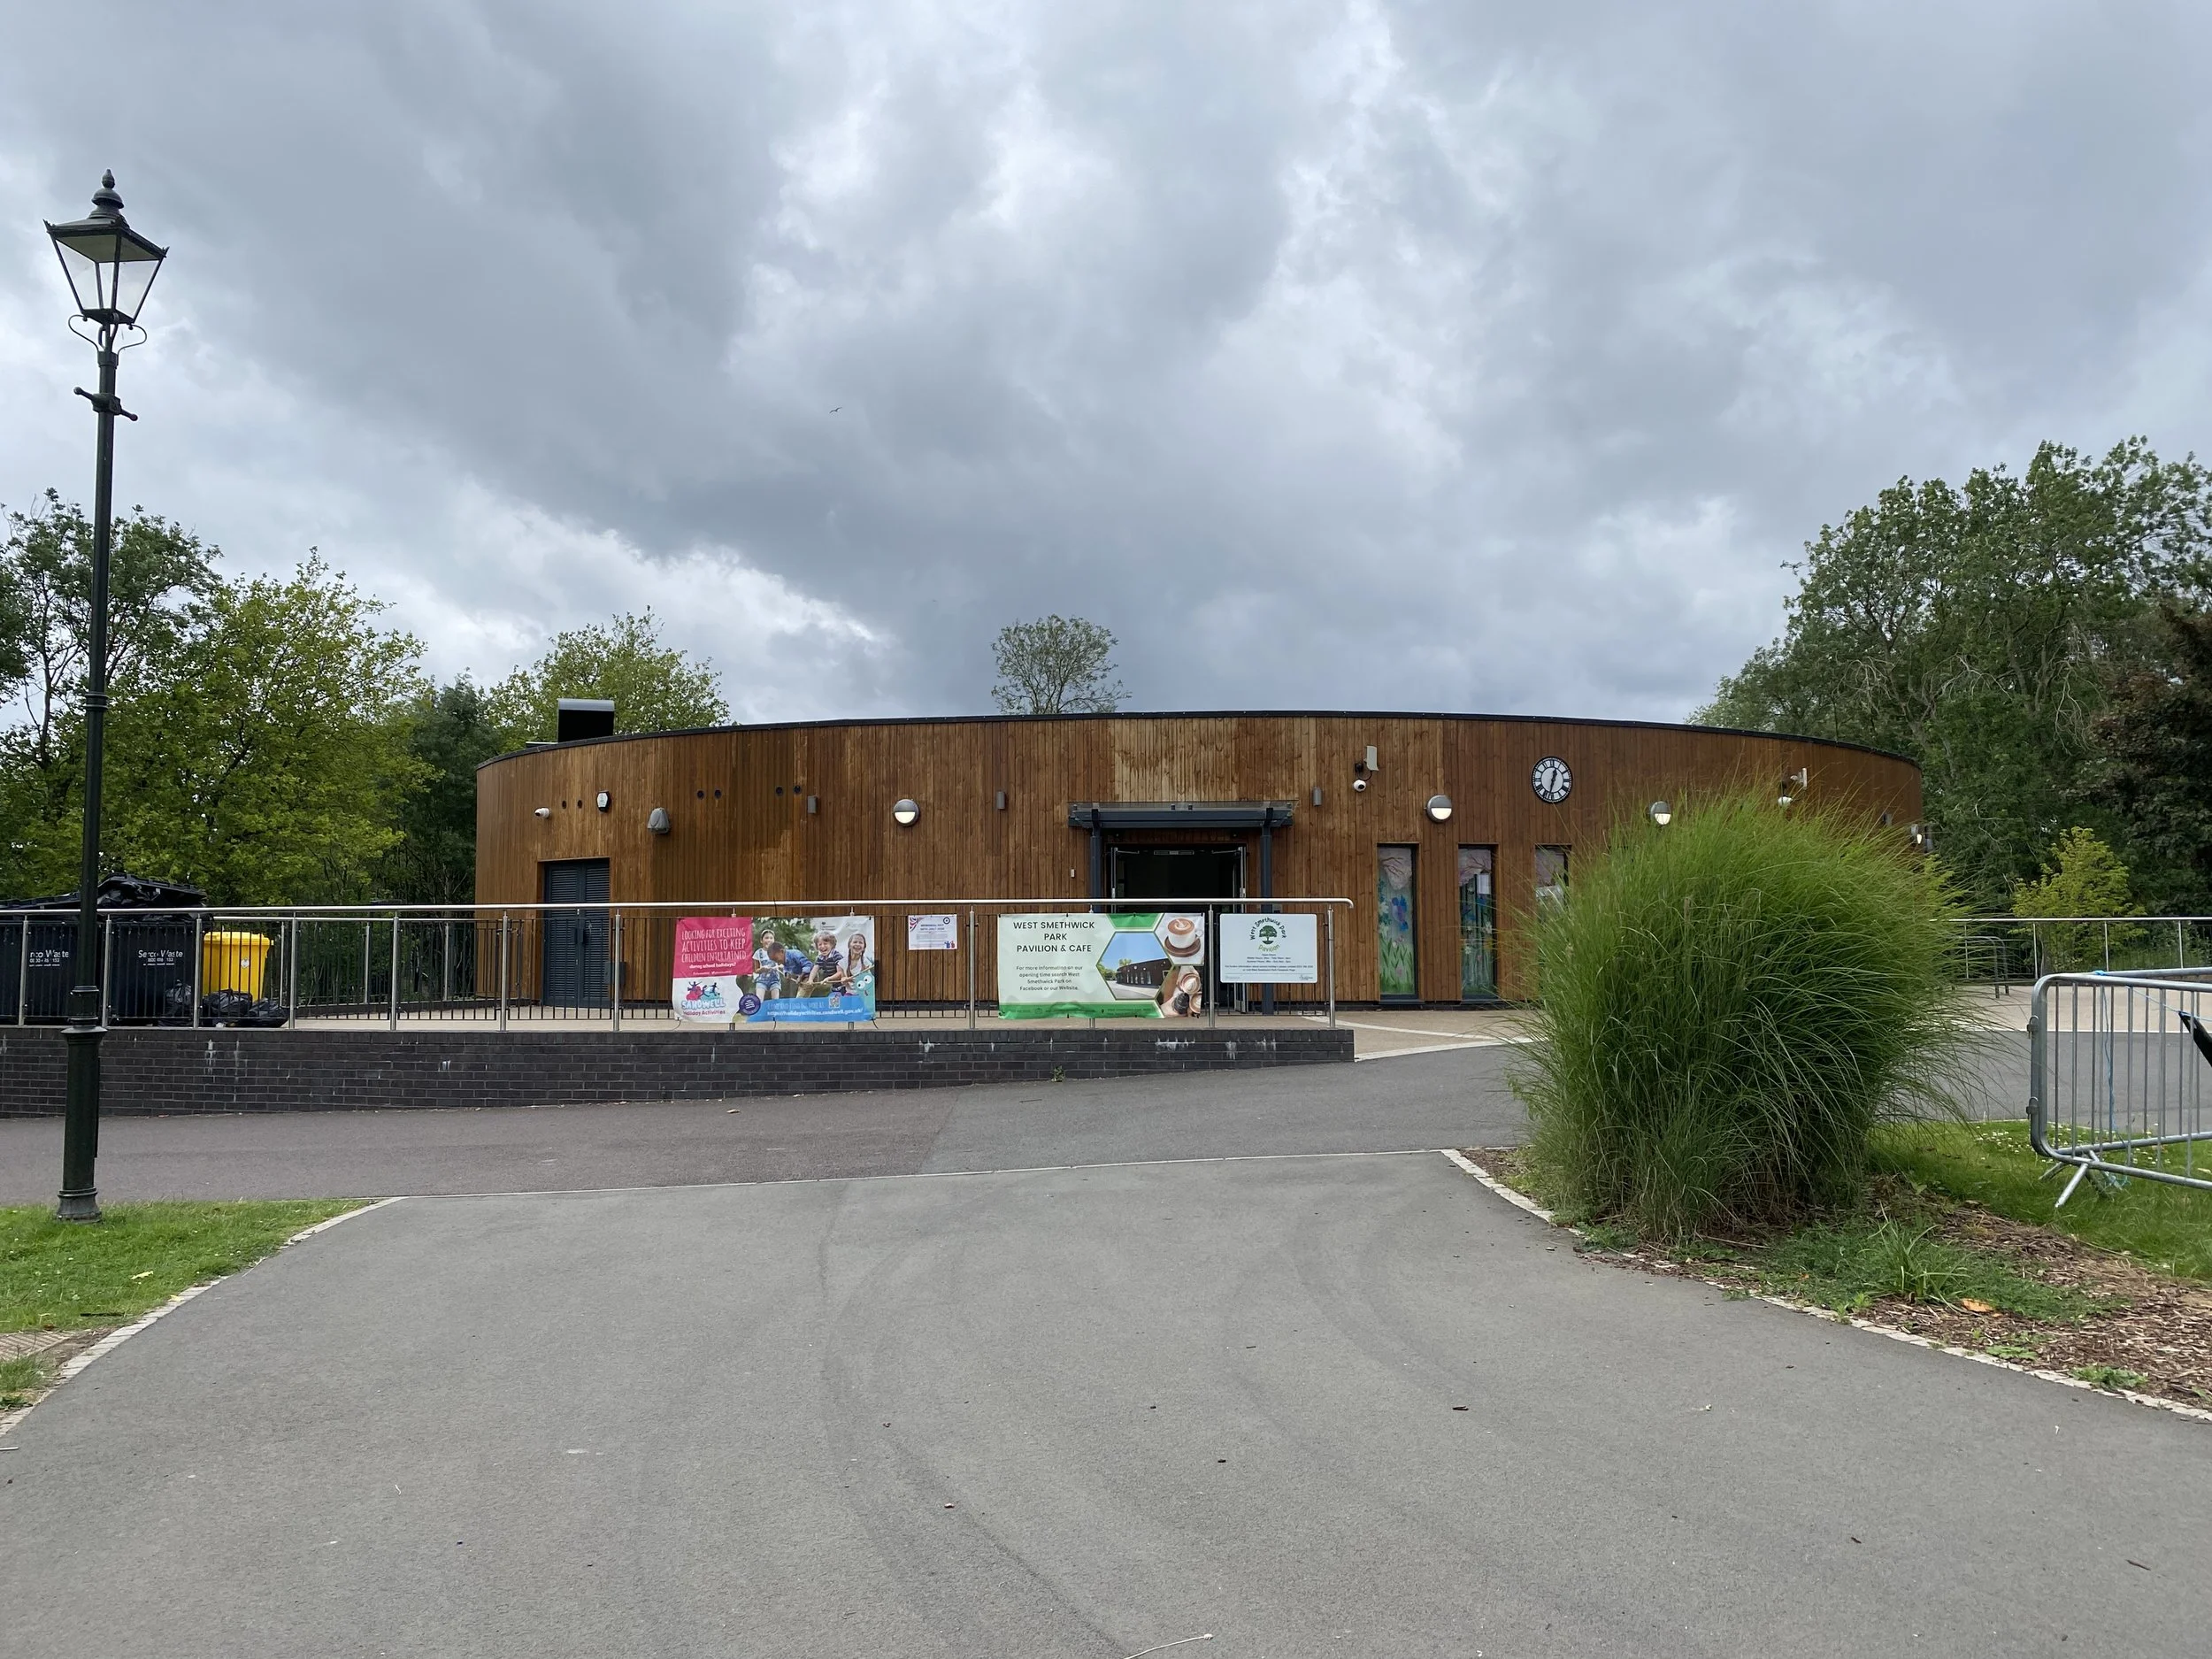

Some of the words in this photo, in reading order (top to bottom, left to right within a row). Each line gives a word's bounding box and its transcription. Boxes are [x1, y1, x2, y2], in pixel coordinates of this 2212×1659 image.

[1255, 917, 1281, 927] Smethwick
[681, 929, 705, 941] LOOKING
[705, 928, 716, 939] FOR
[716, 927, 746, 938] EXCITING
[681, 940, 718, 953] ACTIVITIES
[719, 939, 728, 950] TO
[730, 938, 746, 950] KEEP
[681, 952, 706, 964] CHILDREN
[707, 950, 747, 963] ENTERTAINED
[681, 998, 726, 1010] SANDWELL
